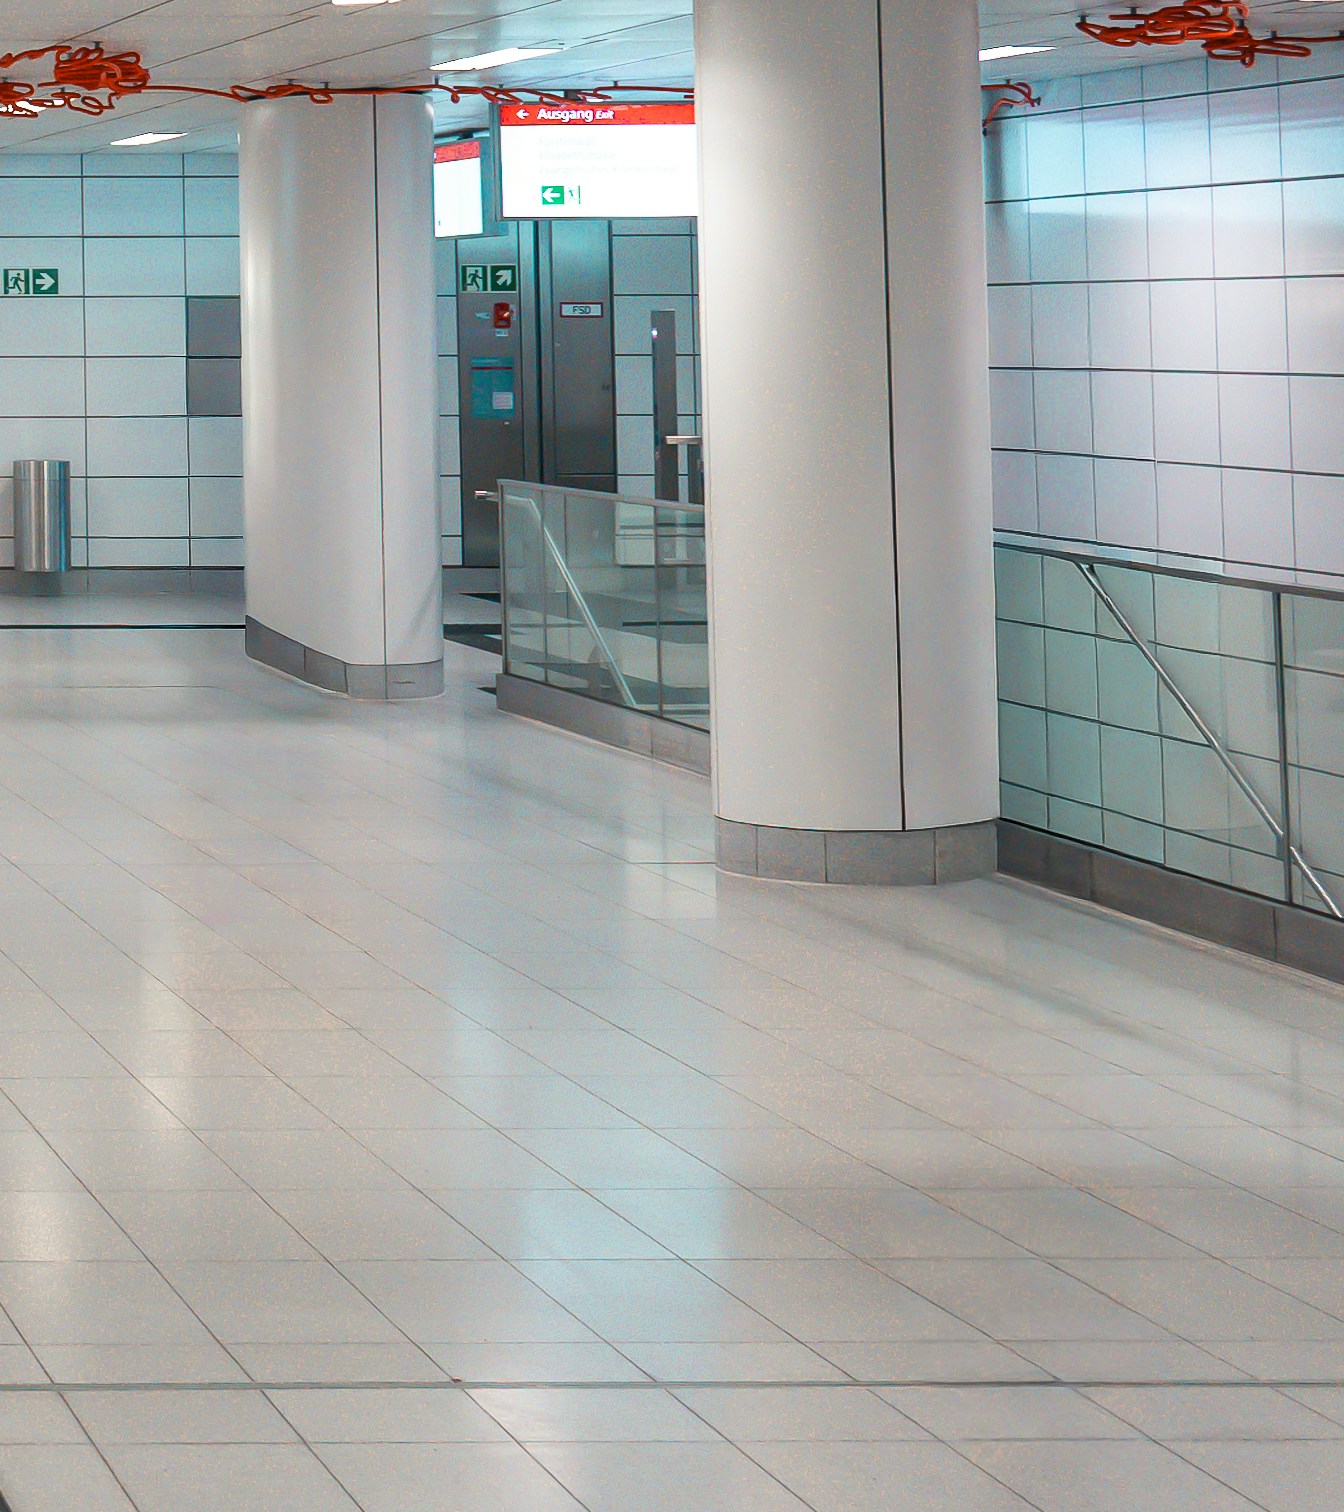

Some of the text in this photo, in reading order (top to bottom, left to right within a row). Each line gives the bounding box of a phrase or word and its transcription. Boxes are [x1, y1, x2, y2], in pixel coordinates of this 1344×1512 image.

[537, 108, 615, 122] Ausgang Exit
[572, 305, 592, 314] FSD
